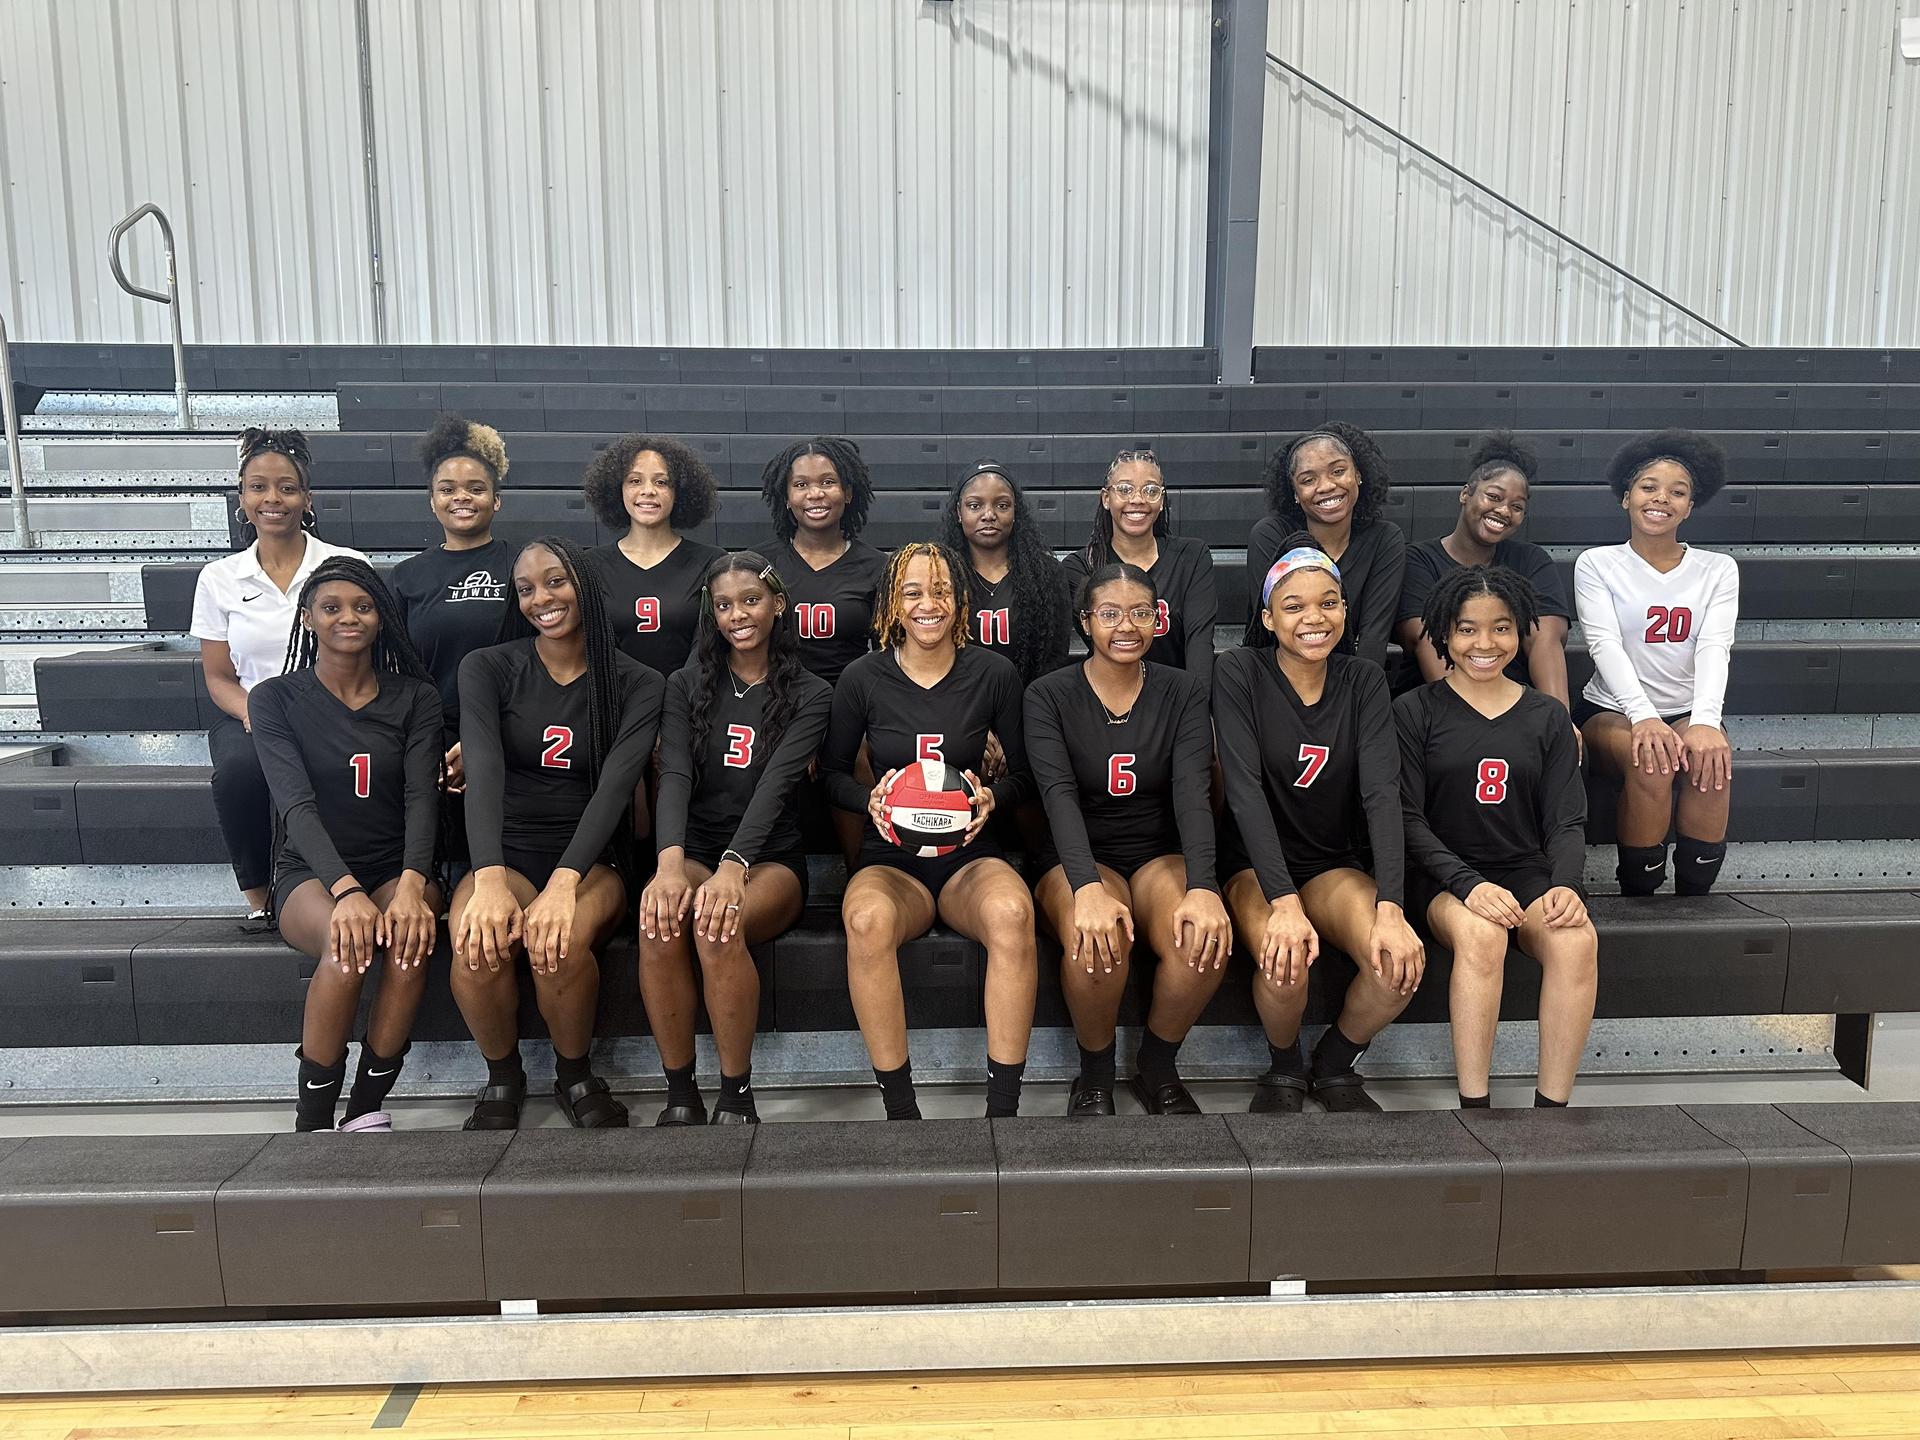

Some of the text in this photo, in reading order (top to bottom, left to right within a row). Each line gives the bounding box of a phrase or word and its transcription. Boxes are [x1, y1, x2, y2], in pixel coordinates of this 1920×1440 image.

[452, 587, 500, 599] HAWKS
[635, 597, 661, 633] 9
[795, 603, 836, 639] 10
[977, 608, 1010, 645] 11
[1645, 606, 1692, 643] 20
[541, 725, 574, 769] 2
[723, 723, 756, 769] 3
[916, 734, 945, 763] 5
[350, 753, 371, 798] 1
[1108, 754, 1137, 797] 6
[1294, 744, 1330, 789] 7
[1476, 758, 1509, 805] 8
[912, 813, 952, 827] TACHIKARA
